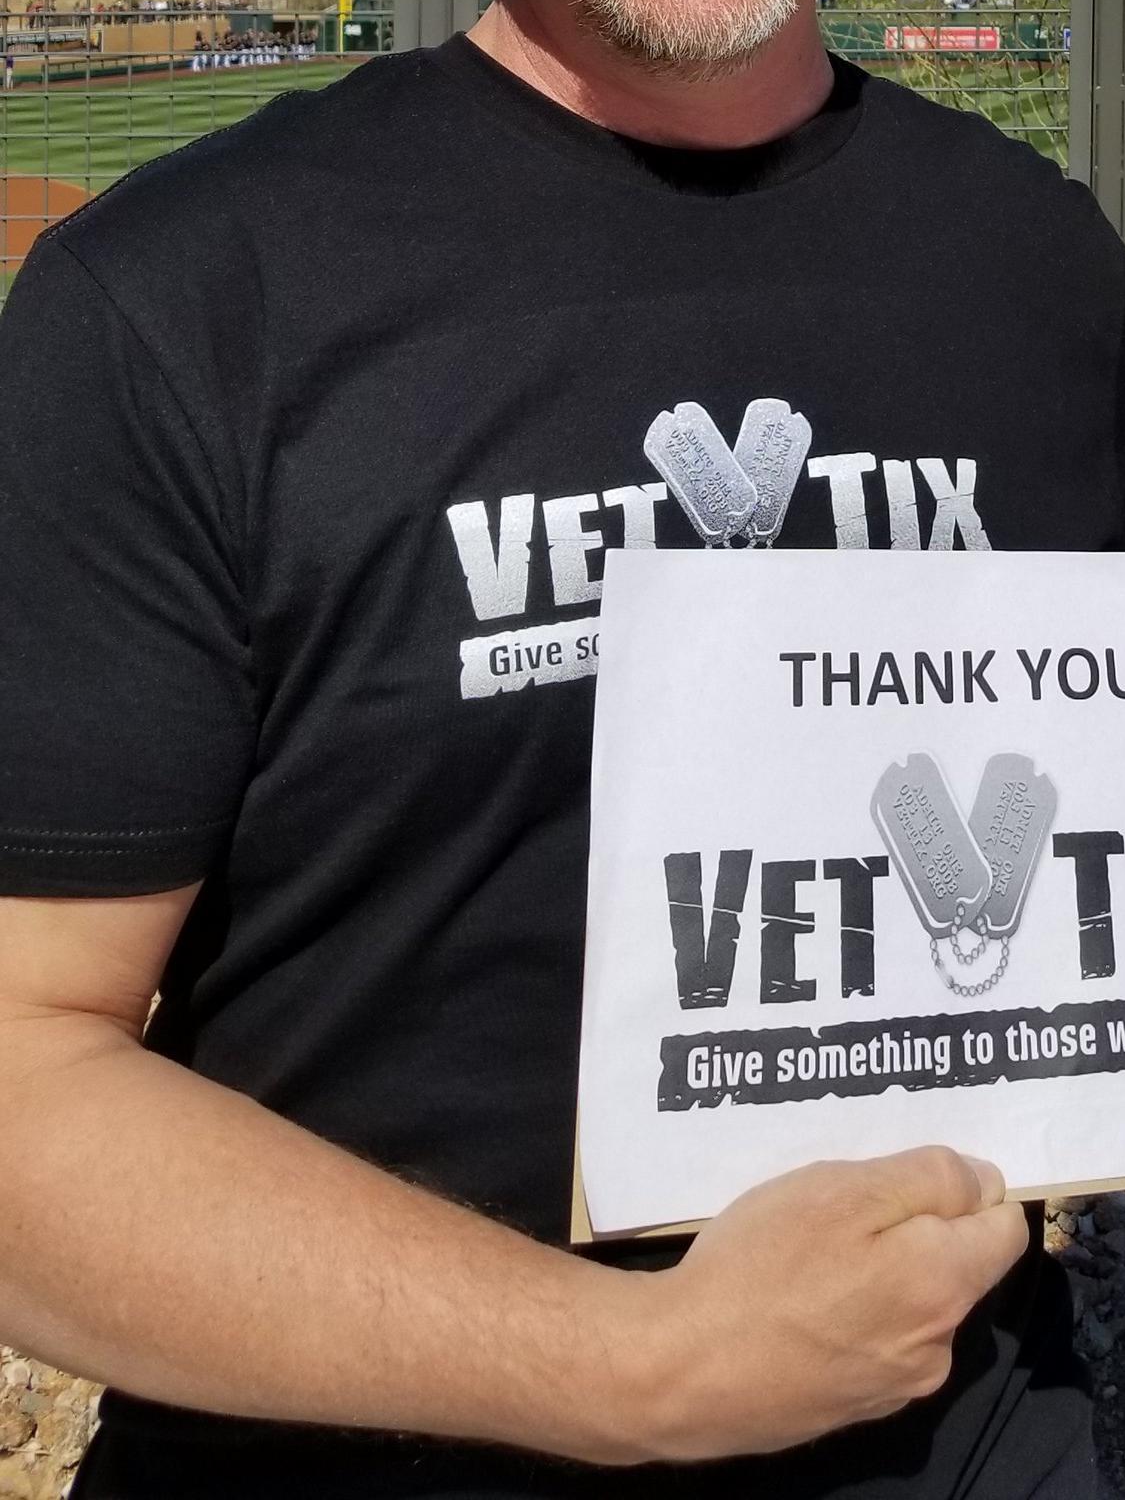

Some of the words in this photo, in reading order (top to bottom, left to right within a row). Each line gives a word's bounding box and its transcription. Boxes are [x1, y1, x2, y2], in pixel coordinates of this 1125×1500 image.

[446, 483, 667, 620] VET
[807, 451, 992, 551] TIX
[489, 642, 562, 676] Give
[780, 649, 999, 707] THANK
[664, 849, 889, 1010] VET
[687, 1045, 763, 1089] Give
[777, 1031, 951, 1083] something
[962, 1028, 994, 1065] to
[1005, 1020, 1096, 1061] those
